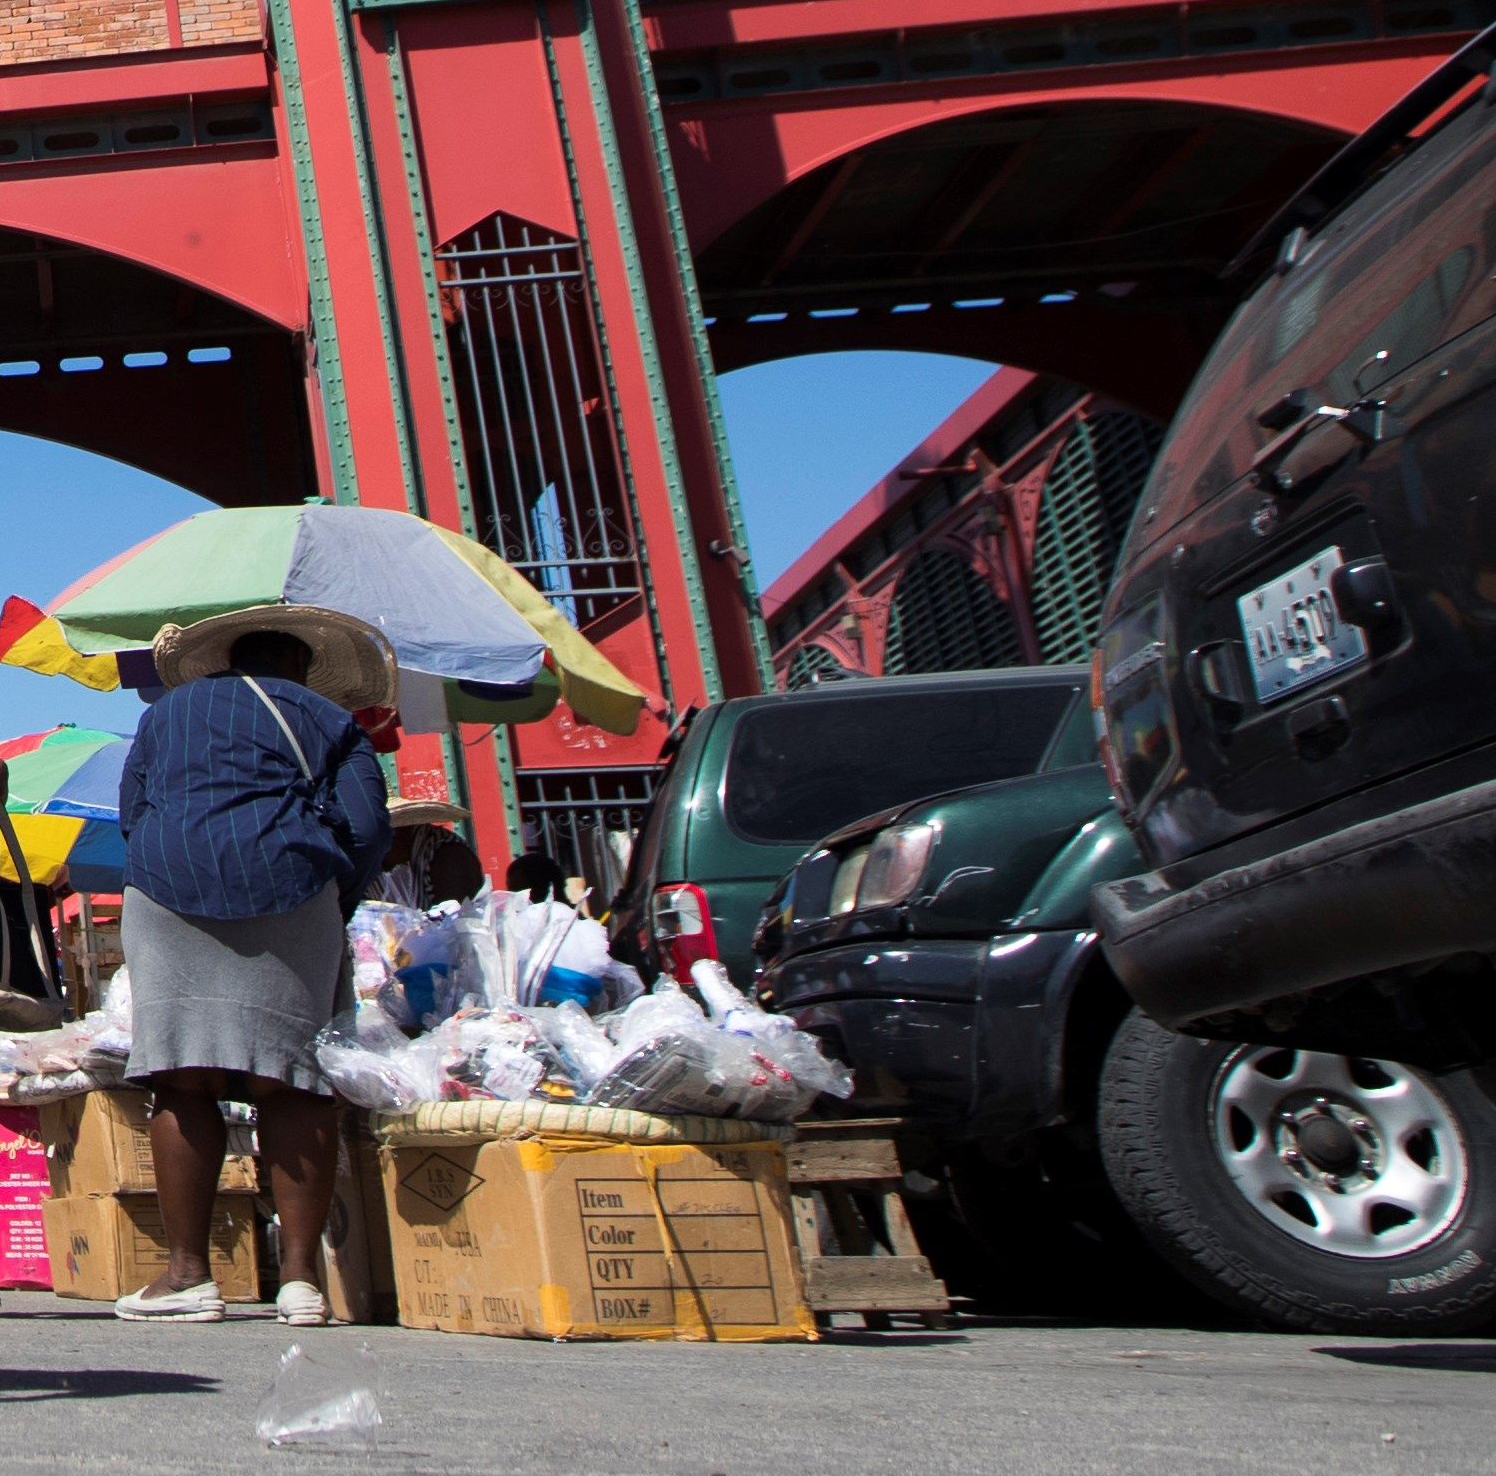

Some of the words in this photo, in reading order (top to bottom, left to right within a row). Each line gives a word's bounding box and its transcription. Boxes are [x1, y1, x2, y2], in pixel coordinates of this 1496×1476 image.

[581, 1188, 624, 1209] Item
[587, 1225, 636, 1245] Color
[596, 1257, 635, 1282] QTY
[417, 1291, 452, 1319] MADE
[458, 1293, 473, 1321] IN
[481, 1295, 523, 1325] CHINA
[599, 1297, 652, 1321] BOX#
